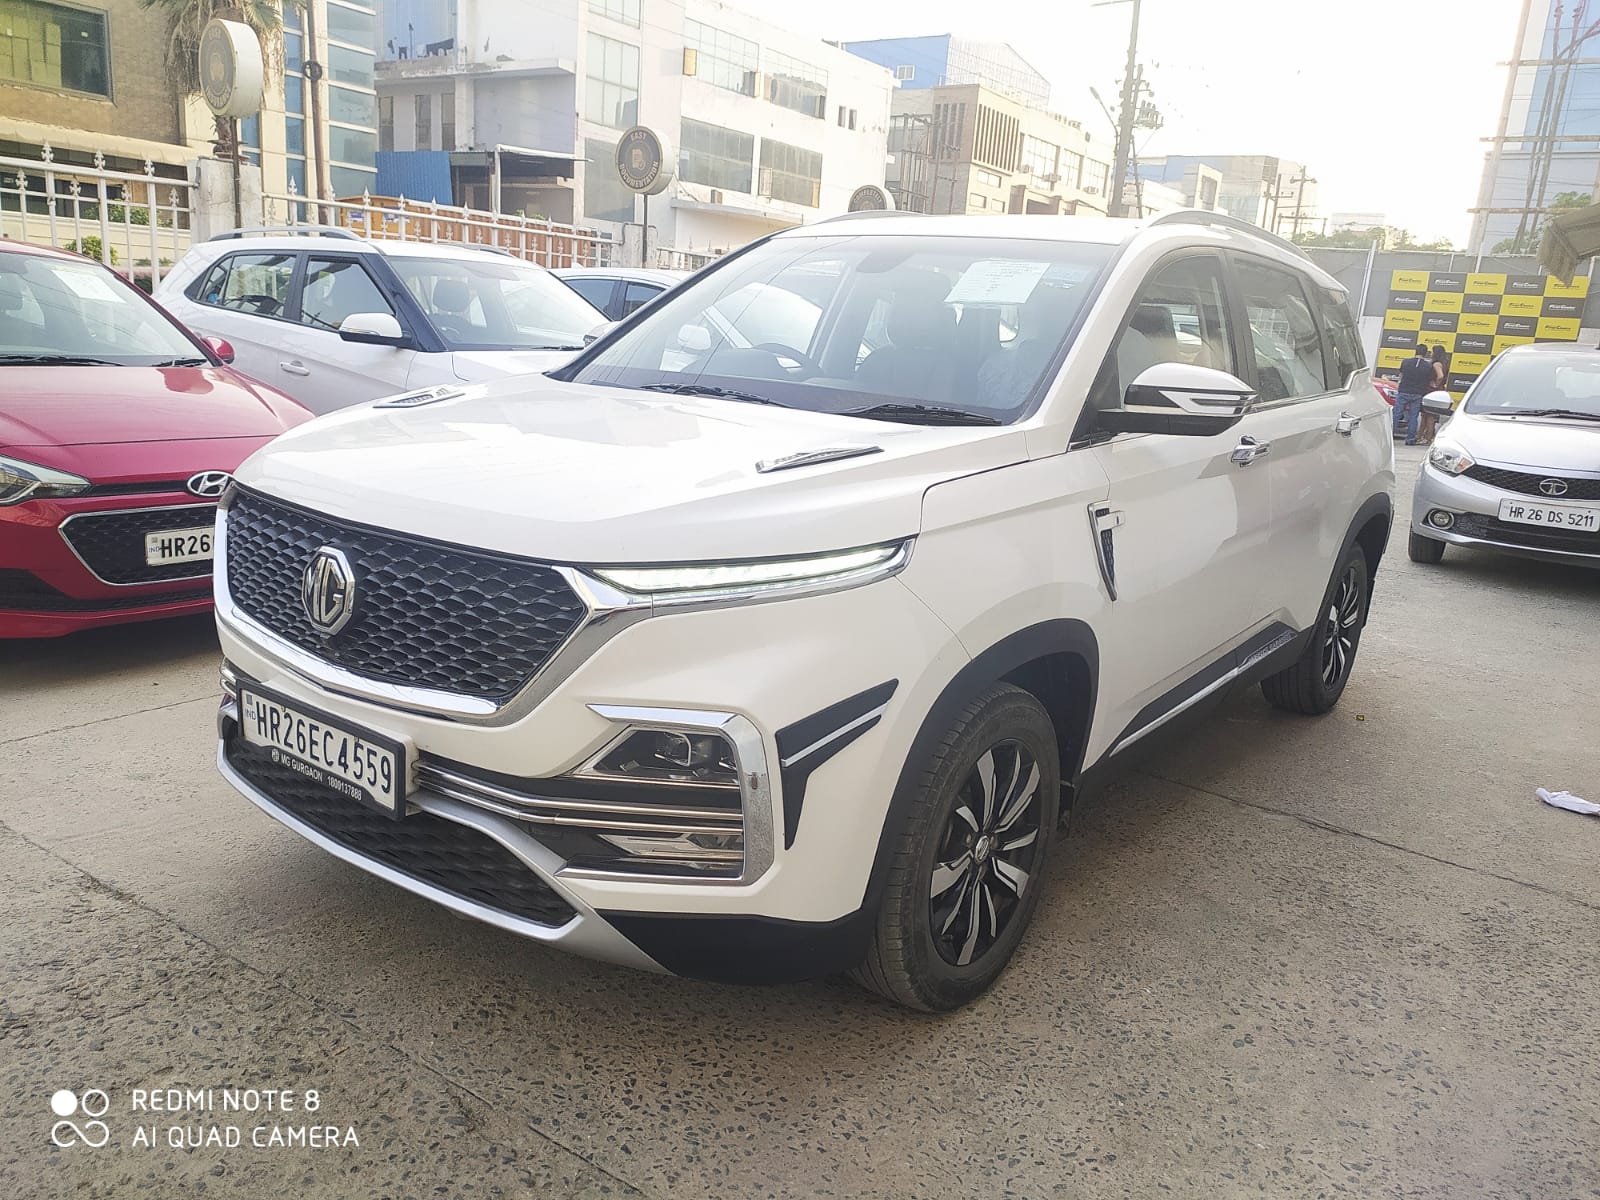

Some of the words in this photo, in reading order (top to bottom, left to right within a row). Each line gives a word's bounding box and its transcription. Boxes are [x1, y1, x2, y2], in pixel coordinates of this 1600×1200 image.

[619, 160, 659, 188] DOCUMENTATION
[1509, 505, 1525, 519] HR
[1527, 508, 1543, 521] 26
[1547, 510, 1563, 523] DS
[1567, 513, 1594, 528] 5211
[161, 534, 214, 558] HR26
[304, 556, 346, 624] MG
[244, 709, 256, 721] IND
[255, 701, 392, 794] HR26EC4559
[281, 753, 291, 767] MG
[291, 758, 323, 783] GURGAON
